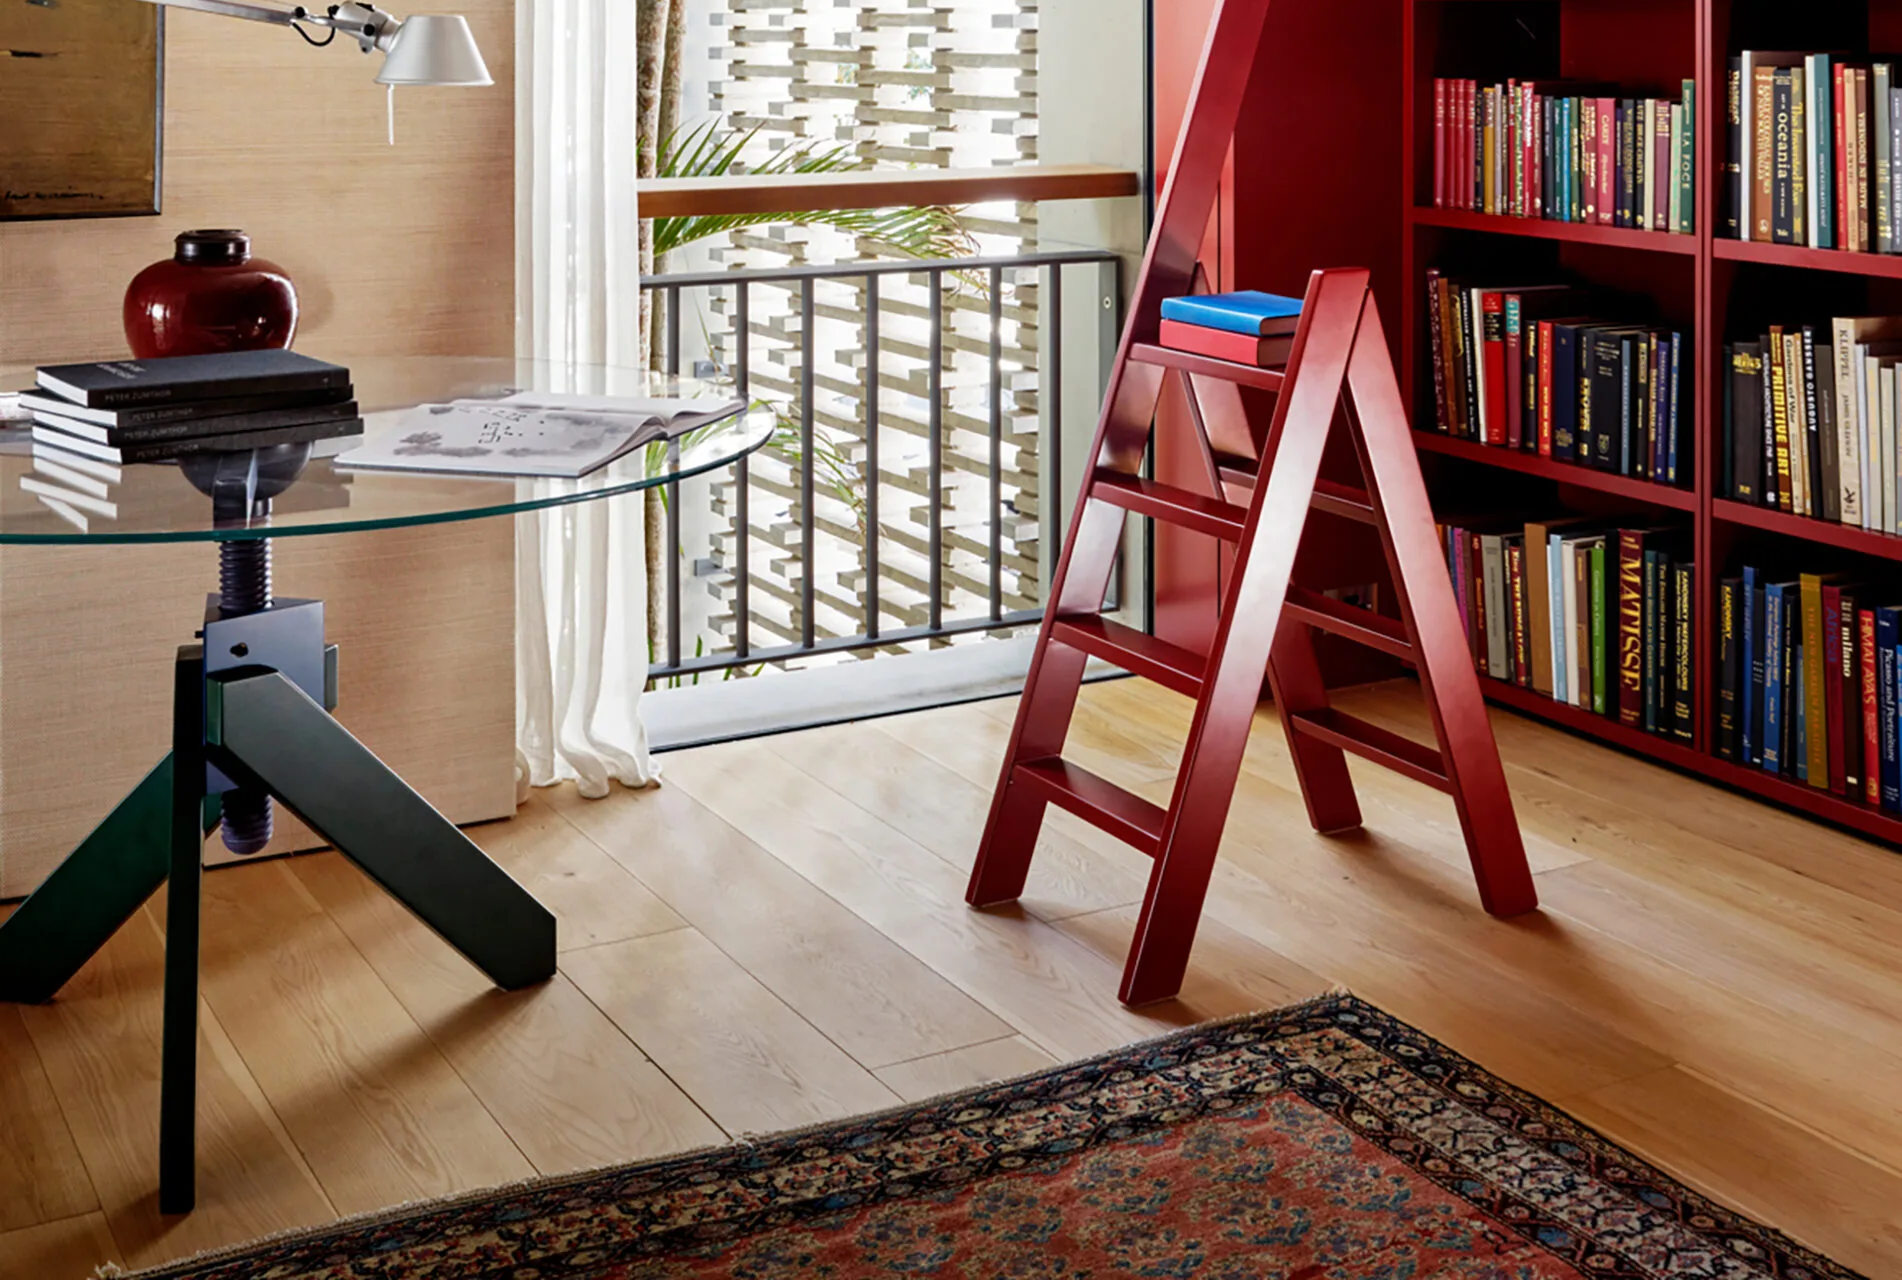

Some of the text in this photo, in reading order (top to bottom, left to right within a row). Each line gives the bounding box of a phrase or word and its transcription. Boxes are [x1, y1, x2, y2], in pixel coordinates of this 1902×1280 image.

[1636, 104, 1644, 120] UTZ
[1791, 102, 1804, 126] The
[1682, 131, 1691, 190] LA FOCE
[1777, 112, 1790, 179] oceania
[1858, 167, 1867, 178] IN
[1858, 181, 1867, 209] MADE
[1839, 329, 1850, 380] KLIPPEL
[104, 388, 173, 402] PETER ZUMTHOR
[1785, 339, 1797, 424] Gardens of War
[1806, 382, 1817, 431] AUGUSTO
[124, 425, 189, 440] PETER ZUMTHOR
[132, 407, 194, 421] PETER ZUMTHOR
[1772, 366, 1789, 476] PRIMITIVE ART
[135, 443, 200, 460] PETER ZUMTHOR
[1620, 556, 1642, 691] MATISSE
[1681, 570, 1689, 691] KANDINSKY WATERCOLOURS
[1724, 584, 1733, 640] KANDINSKY
[1826, 606, 1838, 664] Africa
[1841, 626, 1853, 678] milano
[1809, 657, 1819, 706] GARDEN
[1882, 647, 1897, 763] Picasso and Portraiture
